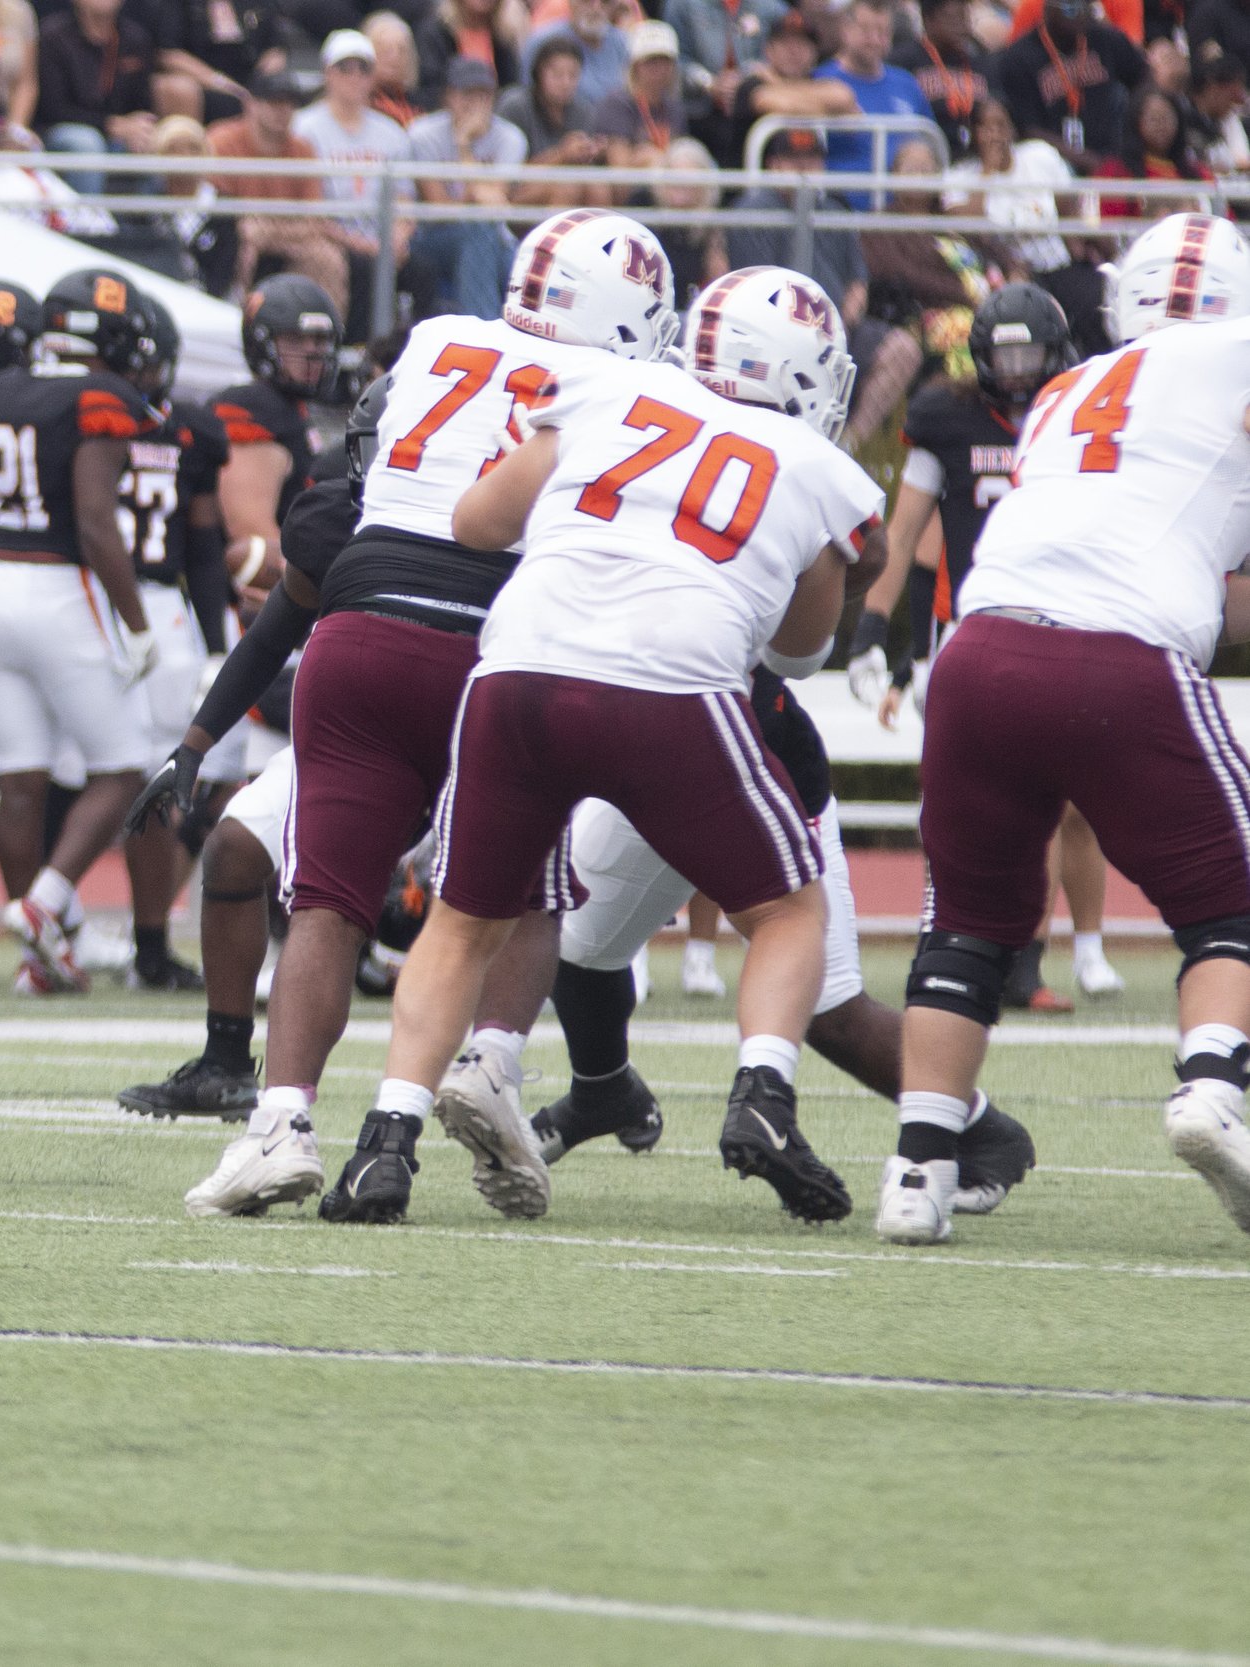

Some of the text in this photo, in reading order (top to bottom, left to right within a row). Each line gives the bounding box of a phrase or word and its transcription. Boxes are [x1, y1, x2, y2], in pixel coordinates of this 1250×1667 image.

[623, 234, 665, 298] M
[787, 281, 834, 340] M
[1013, 347, 1149, 487] 74
[574, 394, 779, 565] 70
